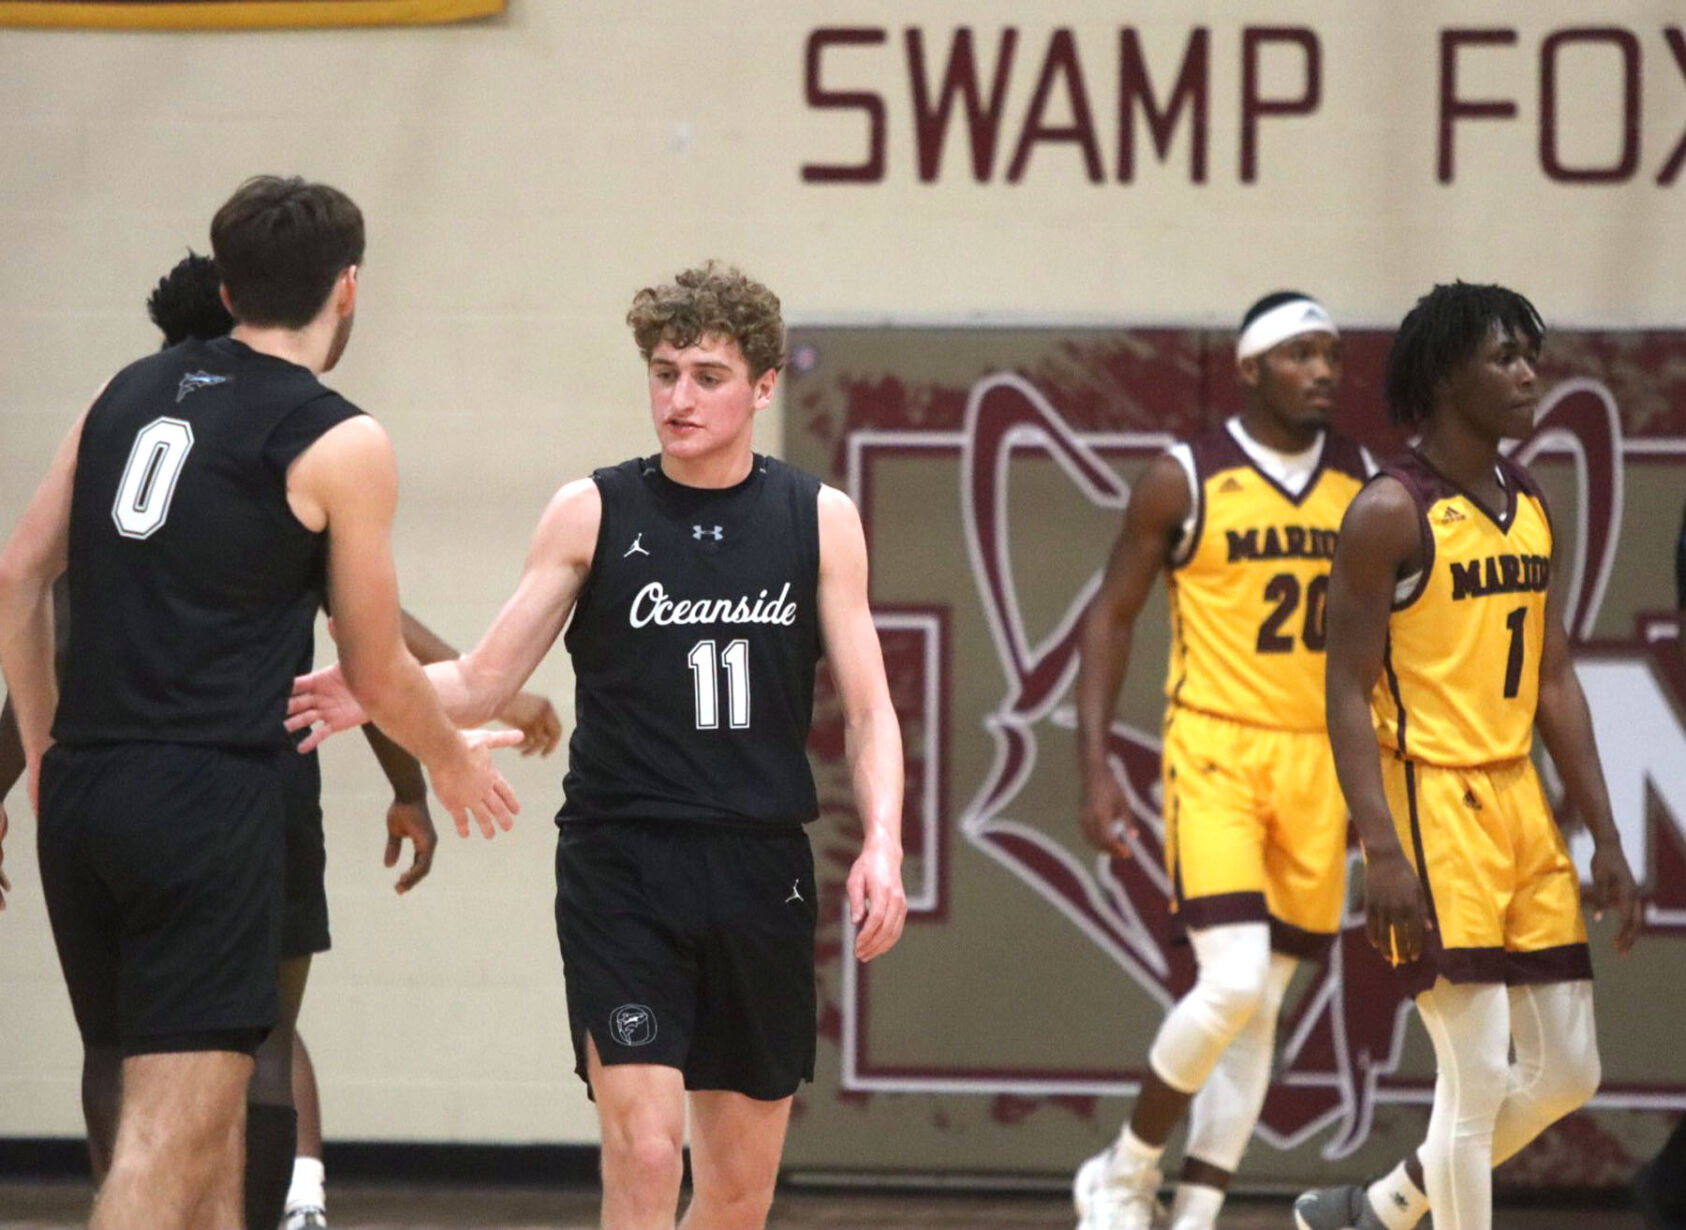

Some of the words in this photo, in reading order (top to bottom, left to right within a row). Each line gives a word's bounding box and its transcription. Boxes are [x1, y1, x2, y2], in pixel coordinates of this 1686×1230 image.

[800, 26, 1321, 184] SWAMP
[111, 416, 195, 539] 0
[629, 582, 797, 628] Oceanside
[1256, 573, 1329, 653] 20
[688, 639, 750, 729] 11
[1503, 607, 1527, 698] 1
